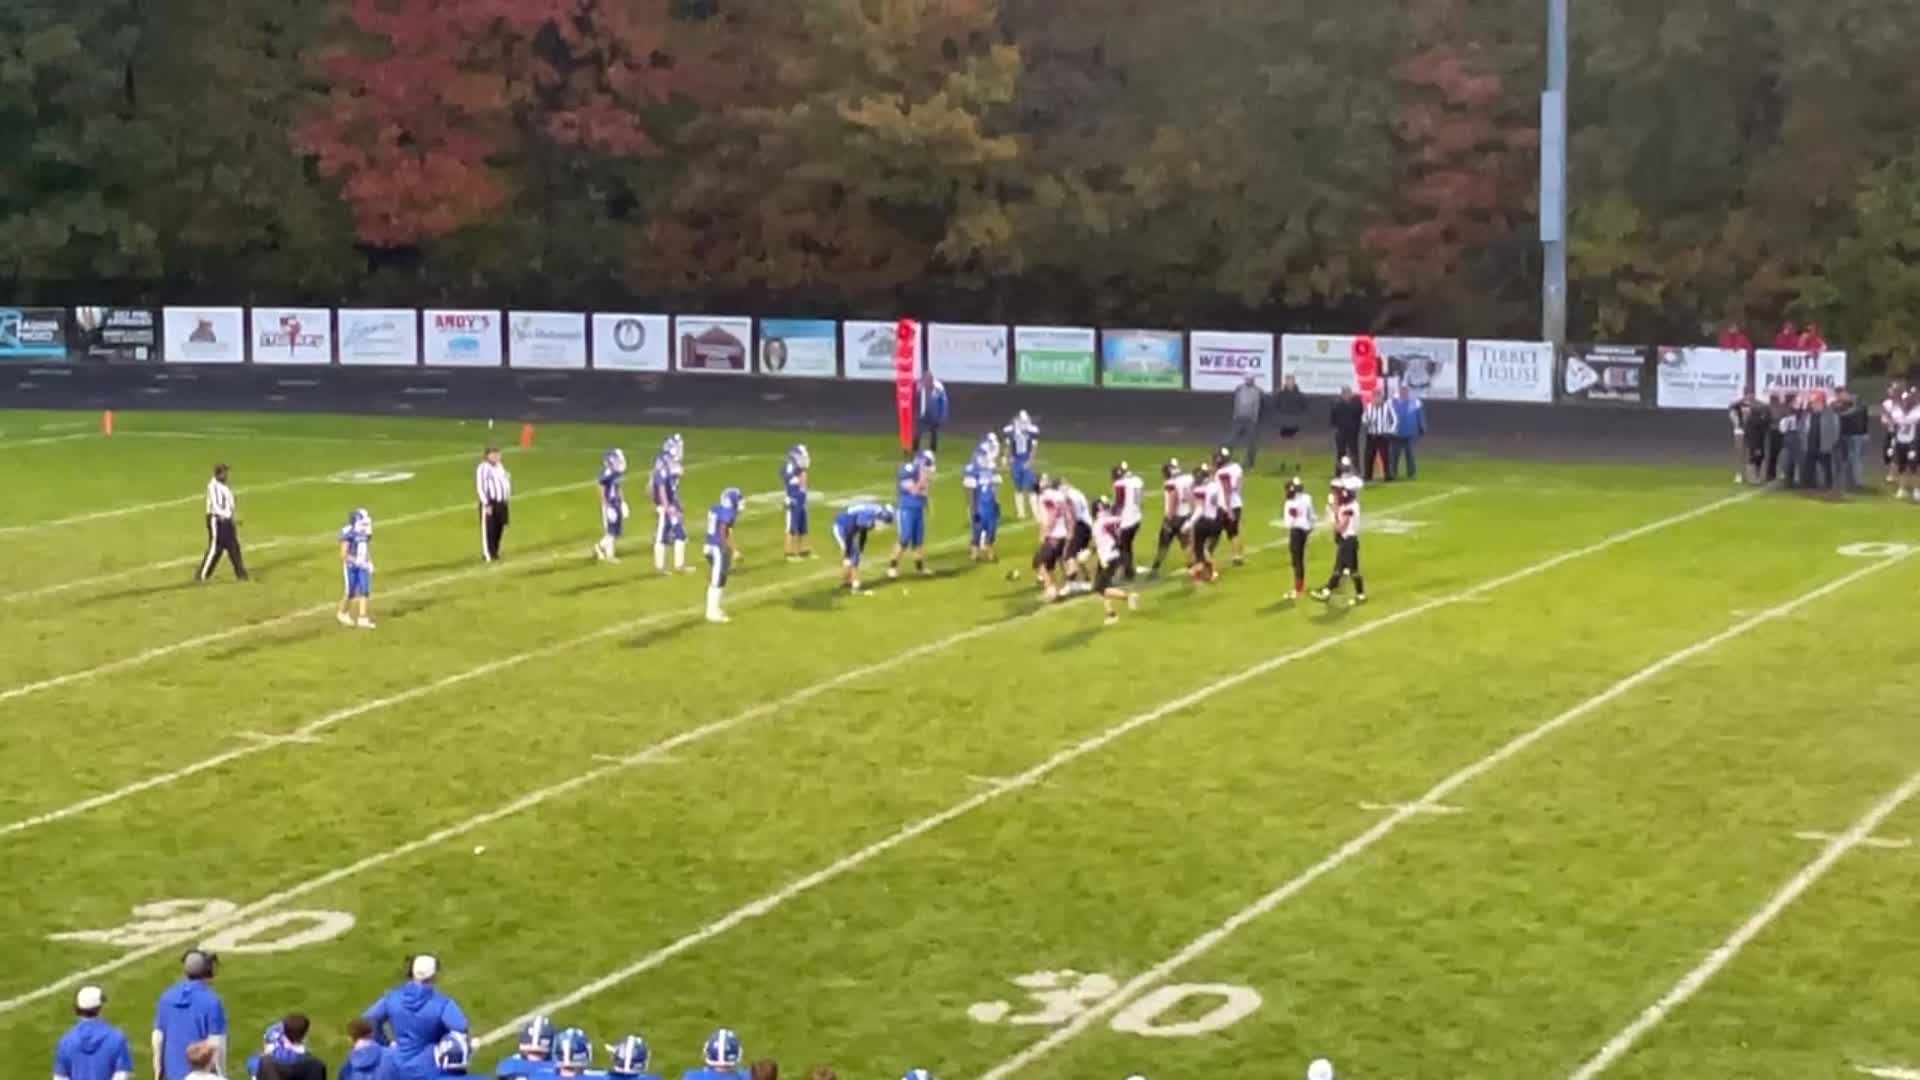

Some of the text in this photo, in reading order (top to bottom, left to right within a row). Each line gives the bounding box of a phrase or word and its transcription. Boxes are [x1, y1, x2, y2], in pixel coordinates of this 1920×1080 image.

[1198, 354, 1262, 370] WESCO
[1764, 373, 1836, 389] PAINTING
[967, 969, 1263, 1037] 30
